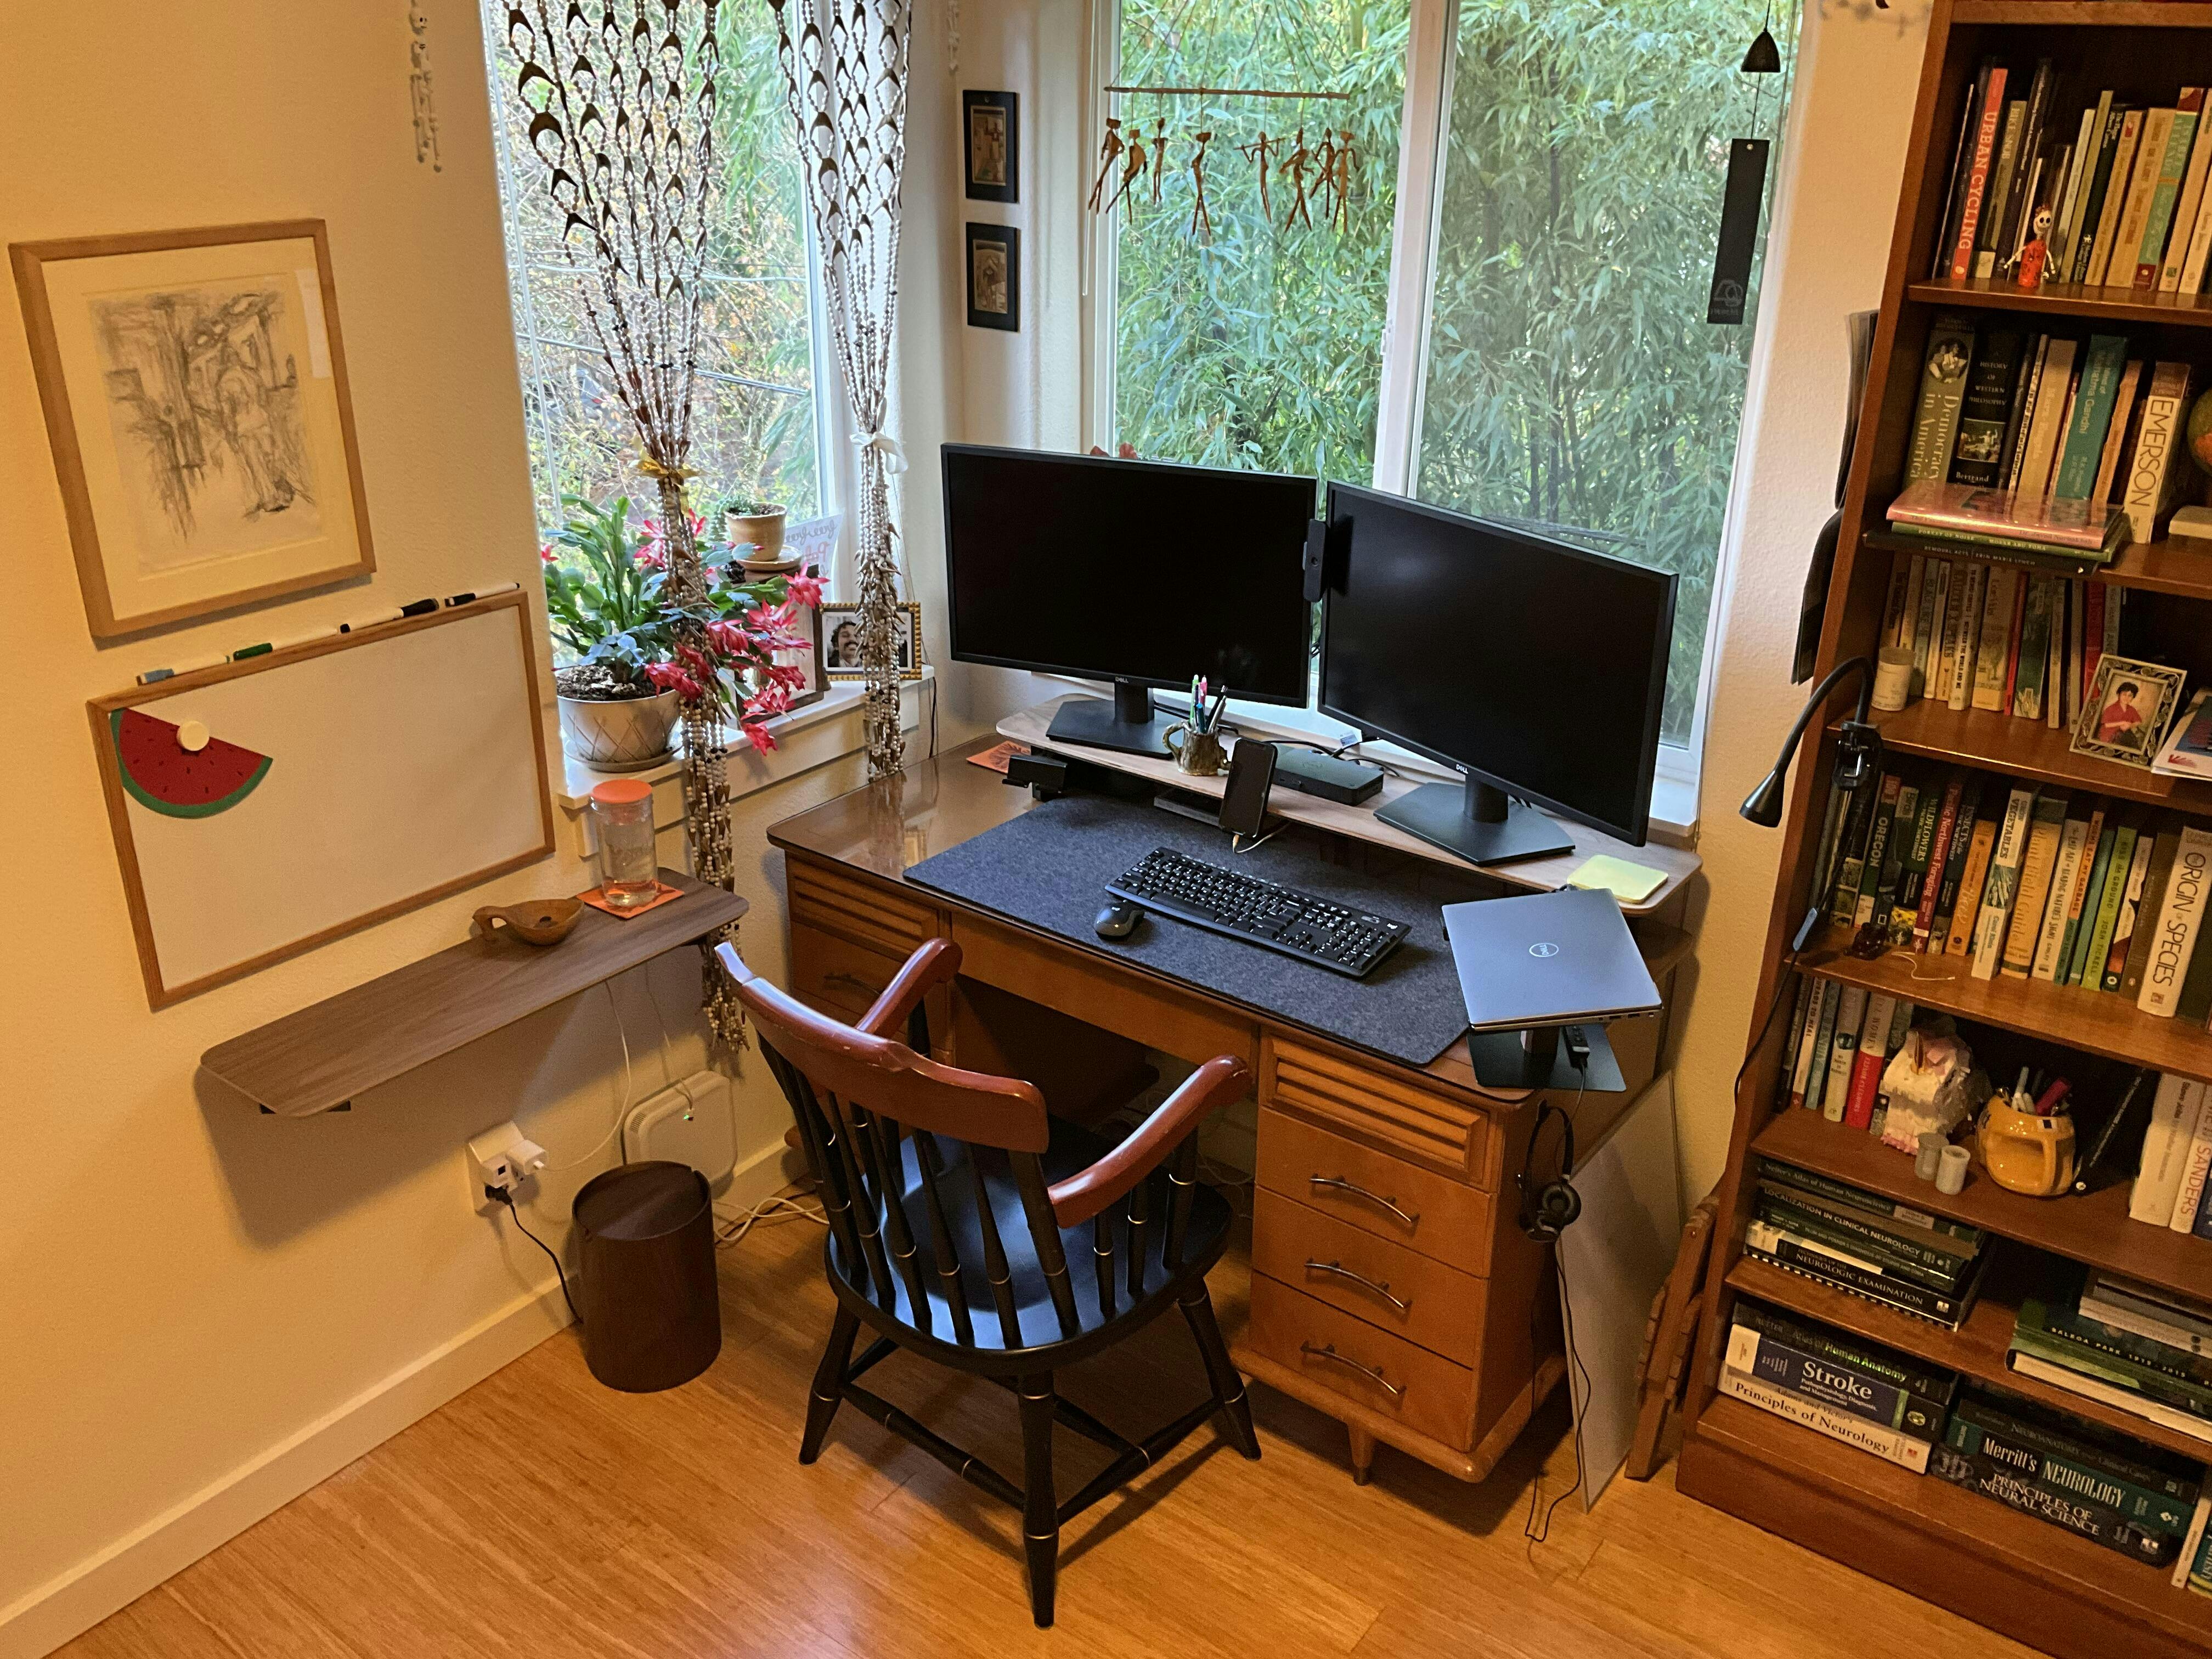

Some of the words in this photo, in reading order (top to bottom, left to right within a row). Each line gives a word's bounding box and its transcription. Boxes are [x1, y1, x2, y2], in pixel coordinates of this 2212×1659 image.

[1972, 111, 1998, 170] URBAN
[2001, 135, 2014, 160] SNOB
[1959, 174, 1985, 250] CYCLING
[1979, 362, 2008, 370] HISTORY
[1922, 391, 1941, 410] in
[1968, 396, 2007, 407] PHILOSOPHY
[1975, 385, 2005, 394] WESTERN
[2077, 398, 2095, 435] Gandhi
[1907, 416, 1936, 479] America
[1923, 393, 1959, 481] Democracy
[2126, 396, 2176, 509] EMERSON
[1955, 471, 1990, 483] Bertrand
[1961, 621, 1970, 644] BETWEEN
[1115, 675, 1129, 684] DELL
[1454, 763, 1470, 775] DELL
[1942, 788, 1959, 817] Pacific
[1867, 816, 1889, 867] OREGON
[1915, 797, 1938, 863] WILDFLOWERS
[1932, 816, 1951, 861] Northwest
[1959, 805, 1975, 843] INSECTS
[1999, 797, 2020, 859] VEGETABLES
[2081, 864, 2089, 875] MY
[2084, 847, 2093, 861] EAT
[1922, 860, 1941, 898] Foraging
[2057, 868, 2070, 893] READING
[2072, 876, 2086, 912] GARBAGE
[2106, 875, 2119, 909] GROUND
[2171, 849, 2207, 913] ORIGIN
[2098, 919, 2109, 940] JOSH
[1539, 944, 1549, 956] DELL
[2089, 943, 2103, 975] TICKELL
[2151, 918, 2188, 988] SPECIES
[1818, 1181, 1845, 1195] Human
[2180, 1145, 2212, 1216] SANDERS
[1762, 1188, 1824, 1216] LOCALIZATION
[1822, 1211, 1833, 1220] IN
[1832, 1216, 1871, 1235] CLINICAL
[1868, 1230, 1922, 1256] NEUROLOGY
[1795, 1254, 1857, 1281] NEUROLOGIC
[1858, 1276, 1923, 1305] EXAMINATION
[1824, 1342, 1862, 1364] Human
[1859, 1356, 1908, 1384] Anatomy
[2095, 1342, 2121, 1355] PARK
[1798, 1384, 1812, 1392] and
[1810, 1388, 1848, 1407] Management
[1800, 1359, 1876, 1401] Stroke
[1735, 1382, 1797, 1415] Principles
[1800, 1408, 1816, 1422] of
[1816, 1416, 1891, 1455] Neurology
[1804, 1398, 1819, 1409] and
[1990, 1473, 2072, 1512] PRINCIPLES
[2071, 1505, 2094, 1522] OF
[2042, 1458, 2126, 1508] NEUROLOGY
[1977, 1477, 2040, 1510] NEURAL
[2038, 1503, 2102, 1536] SCIENCE
